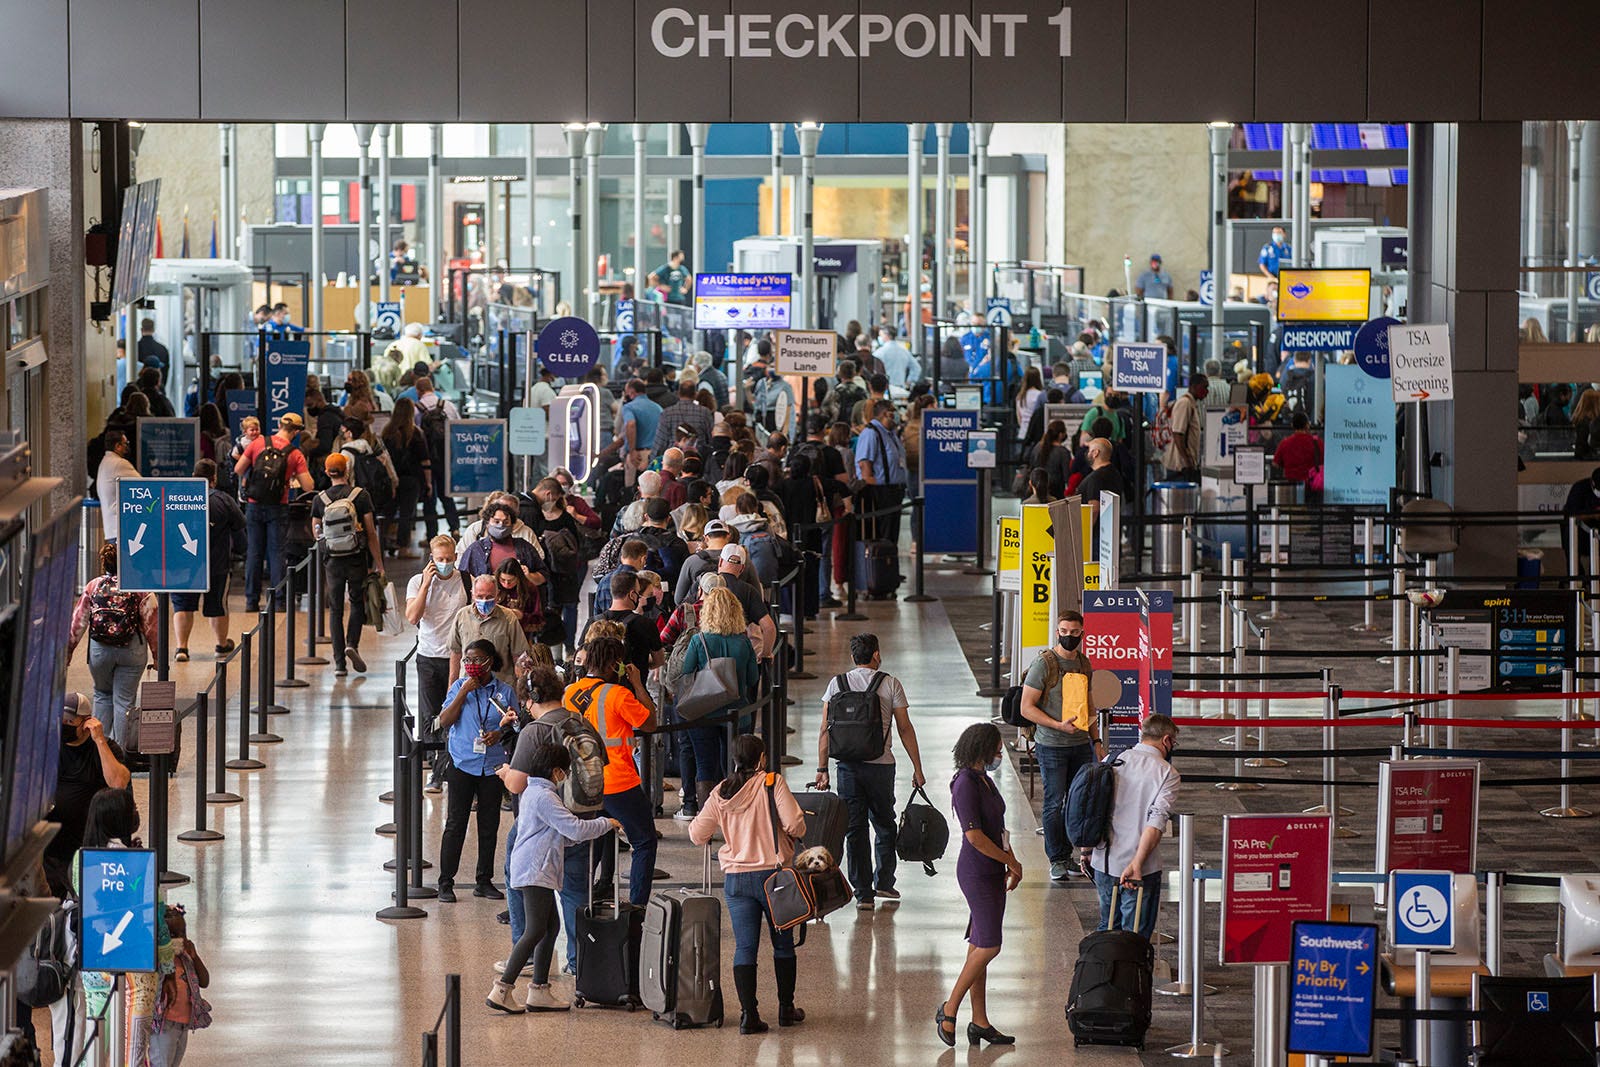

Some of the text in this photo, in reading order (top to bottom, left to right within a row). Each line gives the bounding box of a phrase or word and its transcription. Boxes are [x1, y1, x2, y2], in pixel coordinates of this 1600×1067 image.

[650, 7, 1072, 58] CHECKPOINT 1
[701, 275, 787, 287] #AUSReady4You
[993, 311, 1004, 324] 4
[785, 335, 828, 345] Premium
[1284, 330, 1352, 347] CHECKPOINT
[1406, 330, 1431, 346] TSA
[548, 353, 590, 363] CLEAR
[780, 348, 832, 360] Passenger
[1123, 348, 1157, 360] Regular
[1365, 354, 1388, 364] CLE
[1131, 361, 1149, 372] TSA
[1395, 353, 1445, 369] Oversize
[793, 362, 818, 372] Lane
[1118, 372, 1162, 387] Screening
[1394, 375, 1449, 394] Screening
[271, 377, 290, 412] TSA
[1346, 396, 1372, 405] CLEAR
[931, 417, 972, 428] PREMIUM
[1343, 419, 1377, 429] Touchless
[455, 433, 489, 443] TSA Pre
[926, 429, 967, 440] PASSENG
[1333, 431, 1388, 442] travel that keeps
[465, 443, 489, 453] ONLY
[939, 442, 963, 452] LANE
[1341, 443, 1381, 454] you moving
[456, 456, 498, 465] enter here
[129, 487, 152, 499] TSA
[168, 494, 204, 502] REGULAR
[122, 502, 143, 513] Pre
[165, 503, 207, 511] SCREENING
[1538, 503, 1561, 512] CLE
[1004, 527, 1020, 539] Ba
[1003, 539, 1020, 548] Dro
[1085, 575, 1100, 584] en
[1033, 583, 1049, 603] B
[1107, 597, 1140, 606] DELT
[1483, 598, 1511, 607] spirit
[1085, 635, 1120, 647] SKY
[1085, 647, 1164, 659] PRIORY
[1394, 787, 1423, 796] TSA Pre
[1232, 839, 1266, 849] TSA Pre
[1273, 851, 1299, 859] selected?
[100, 862, 126, 876] TSA
[102, 878, 125, 892] Pre
[1300, 935, 1363, 950] Southwest
[1297, 959, 1337, 974] Fly By
[1297, 974, 1347, 991] Priority
